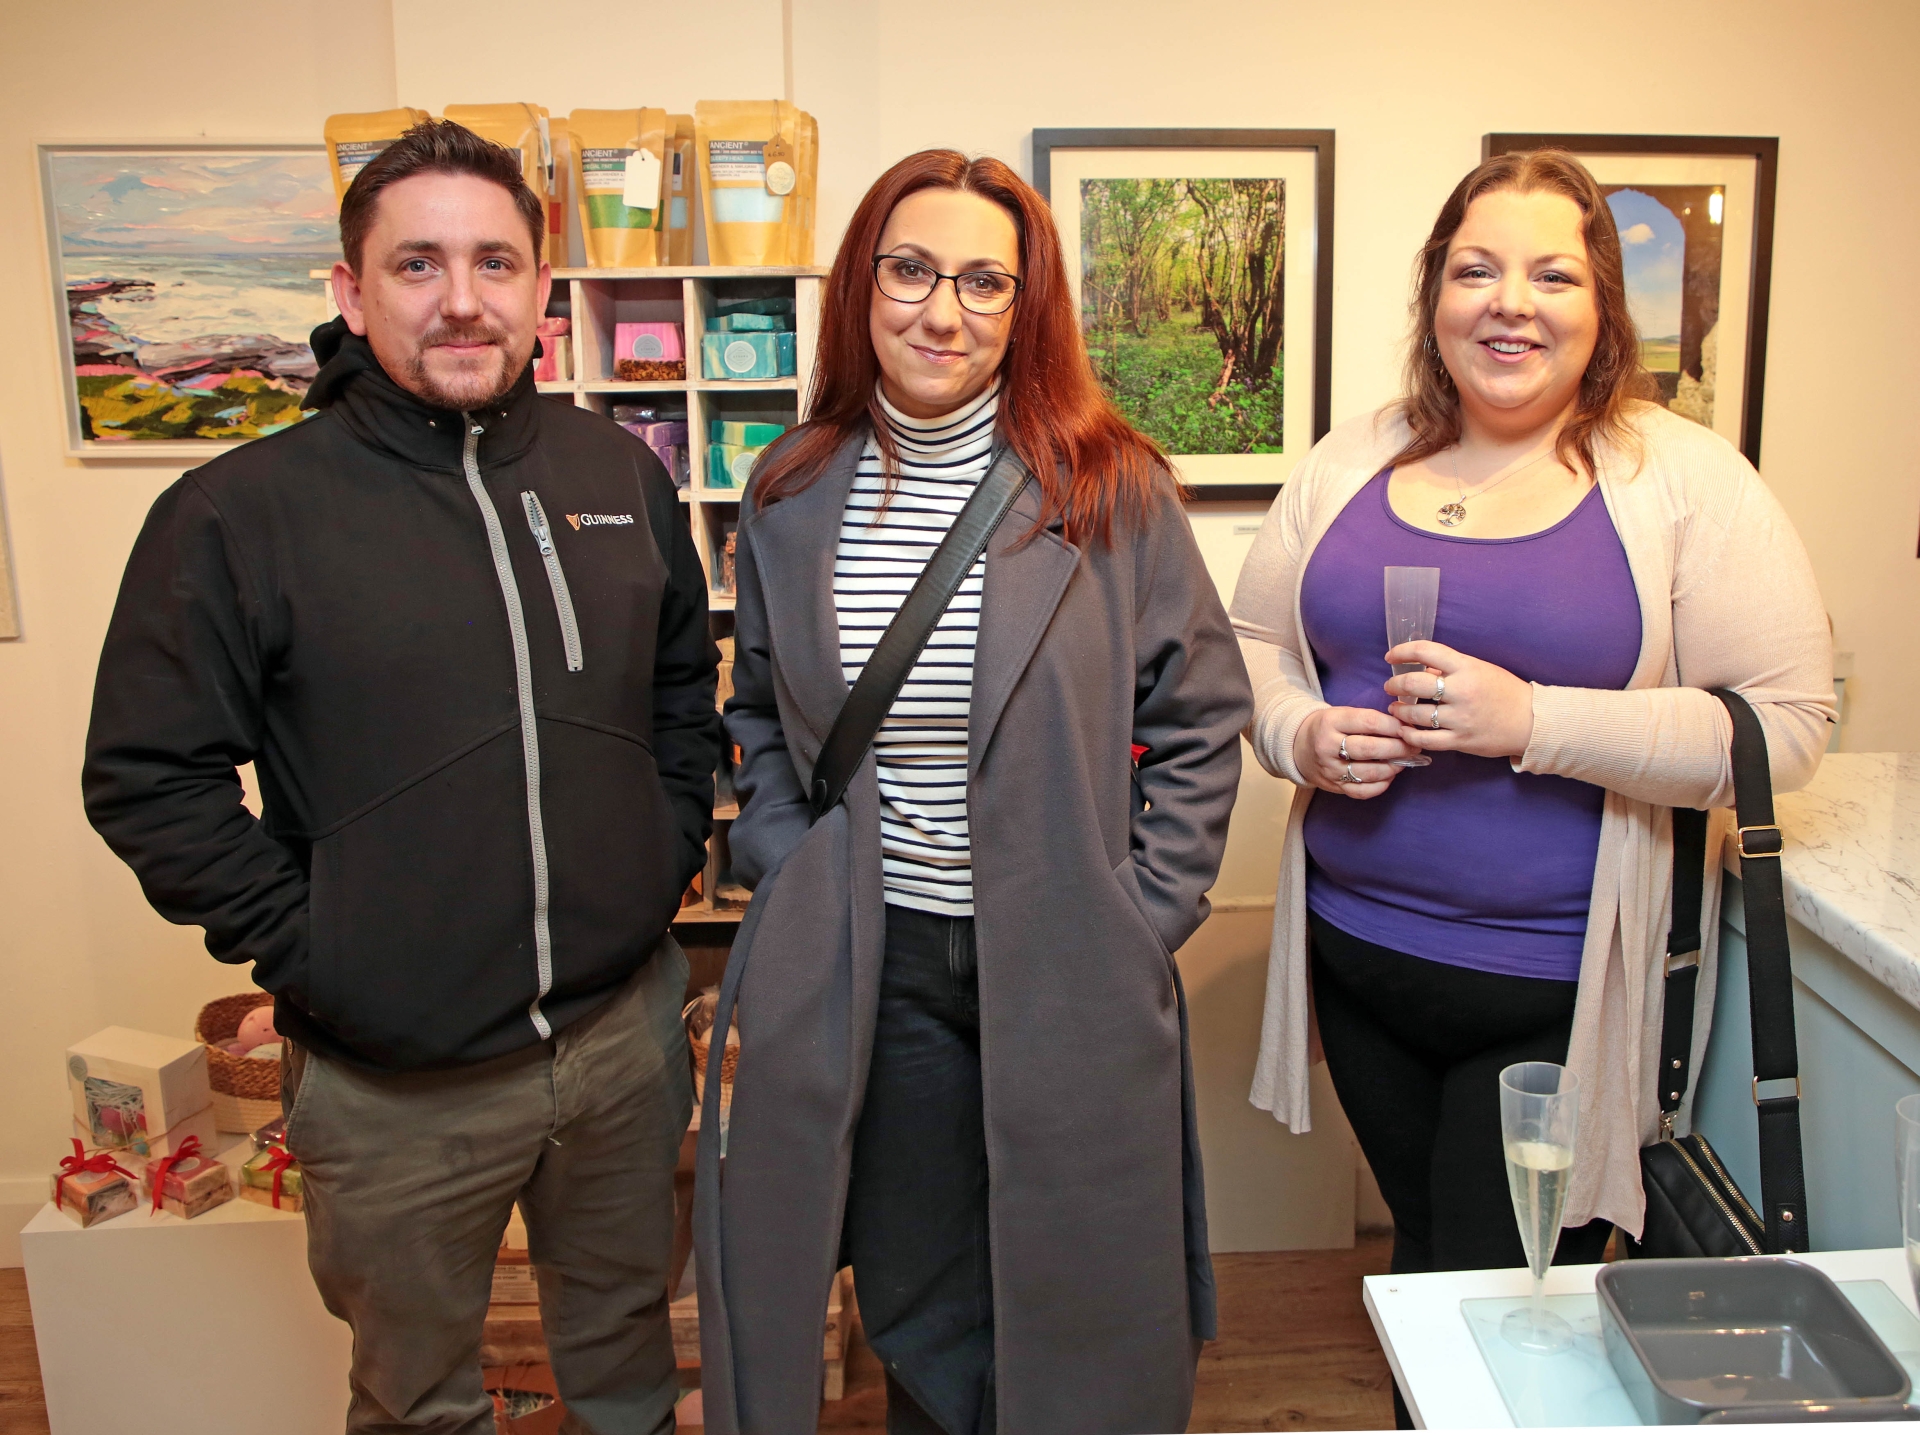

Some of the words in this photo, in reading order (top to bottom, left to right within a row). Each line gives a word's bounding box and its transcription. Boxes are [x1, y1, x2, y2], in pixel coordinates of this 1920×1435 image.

[336, 143, 368, 151] ANCIENT
[582, 149, 613, 157] ANCIENT
[580, 513, 634, 525] GUINNESS
